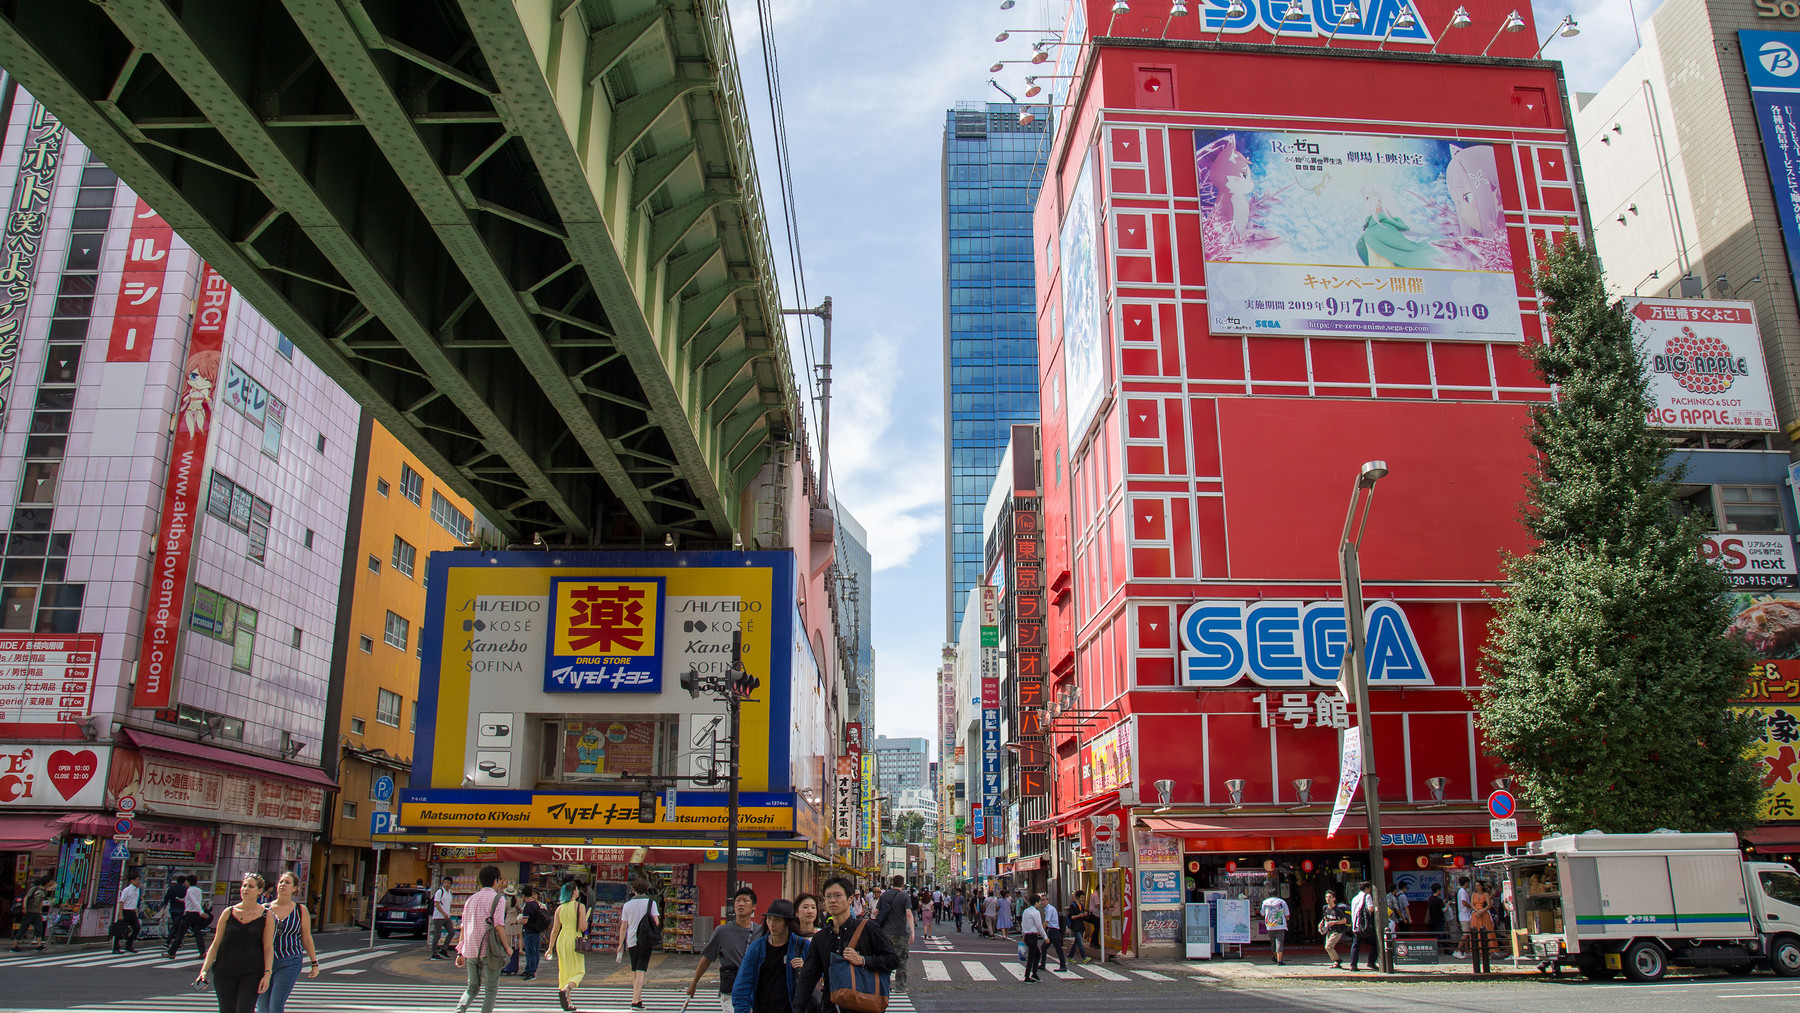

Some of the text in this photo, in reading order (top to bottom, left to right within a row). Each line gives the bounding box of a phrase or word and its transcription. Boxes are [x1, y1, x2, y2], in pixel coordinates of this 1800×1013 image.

[1347, 151, 1423, 165] 劇場上映決定
[1303, 273, 1425, 293] キャンペーン開催
[1244, 299, 1285, 311] 実施期間
[1651, 306, 1740, 321] 万世橋すぐよこ!
[1255, 320, 1281, 328] SEGA
[1653, 354, 1748, 376] BIG APPLE
[1671, 398, 1715, 407] PACHINKO
[1721, 399, 1742, 407] SLOT
[1647, 408, 1677, 424] BIG
[1734, 417, 1773, 427] 秋葉原店
[1751, 557, 1786, 569] next
[147, 449, 195, 694] www.akibalovemerci.com
[455, 599, 541, 613] SHISEIDO
[675, 599, 762, 613] SHISEIDO
[490, 620, 532, 633] KOSÉ
[568, 585, 645, 654] 薬
[711, 620, 754, 633] KOSÉ
[462, 639, 528, 655] Kanebo
[684, 639, 751, 655] Kaneo
[1179, 601, 1436, 686] SEGA
[466, 660, 523, 673] SOFINA
[576, 657, 631, 665] DRUG STORE
[1017, 540, 1041, 794] 東京ラジオデパート
[551, 666, 654, 690] マツモトキヨシ
[1253, 692, 1350, 729] 1号館
[983, 710, 999, 806] ホビーステーション
[147, 769, 204, 793] 大人の通信販売
[122, 799, 133, 809] 20
[420, 810, 531, 822] Matsumoto KiYoshi
[1381, 834, 1454, 846] SEGA 1号館
